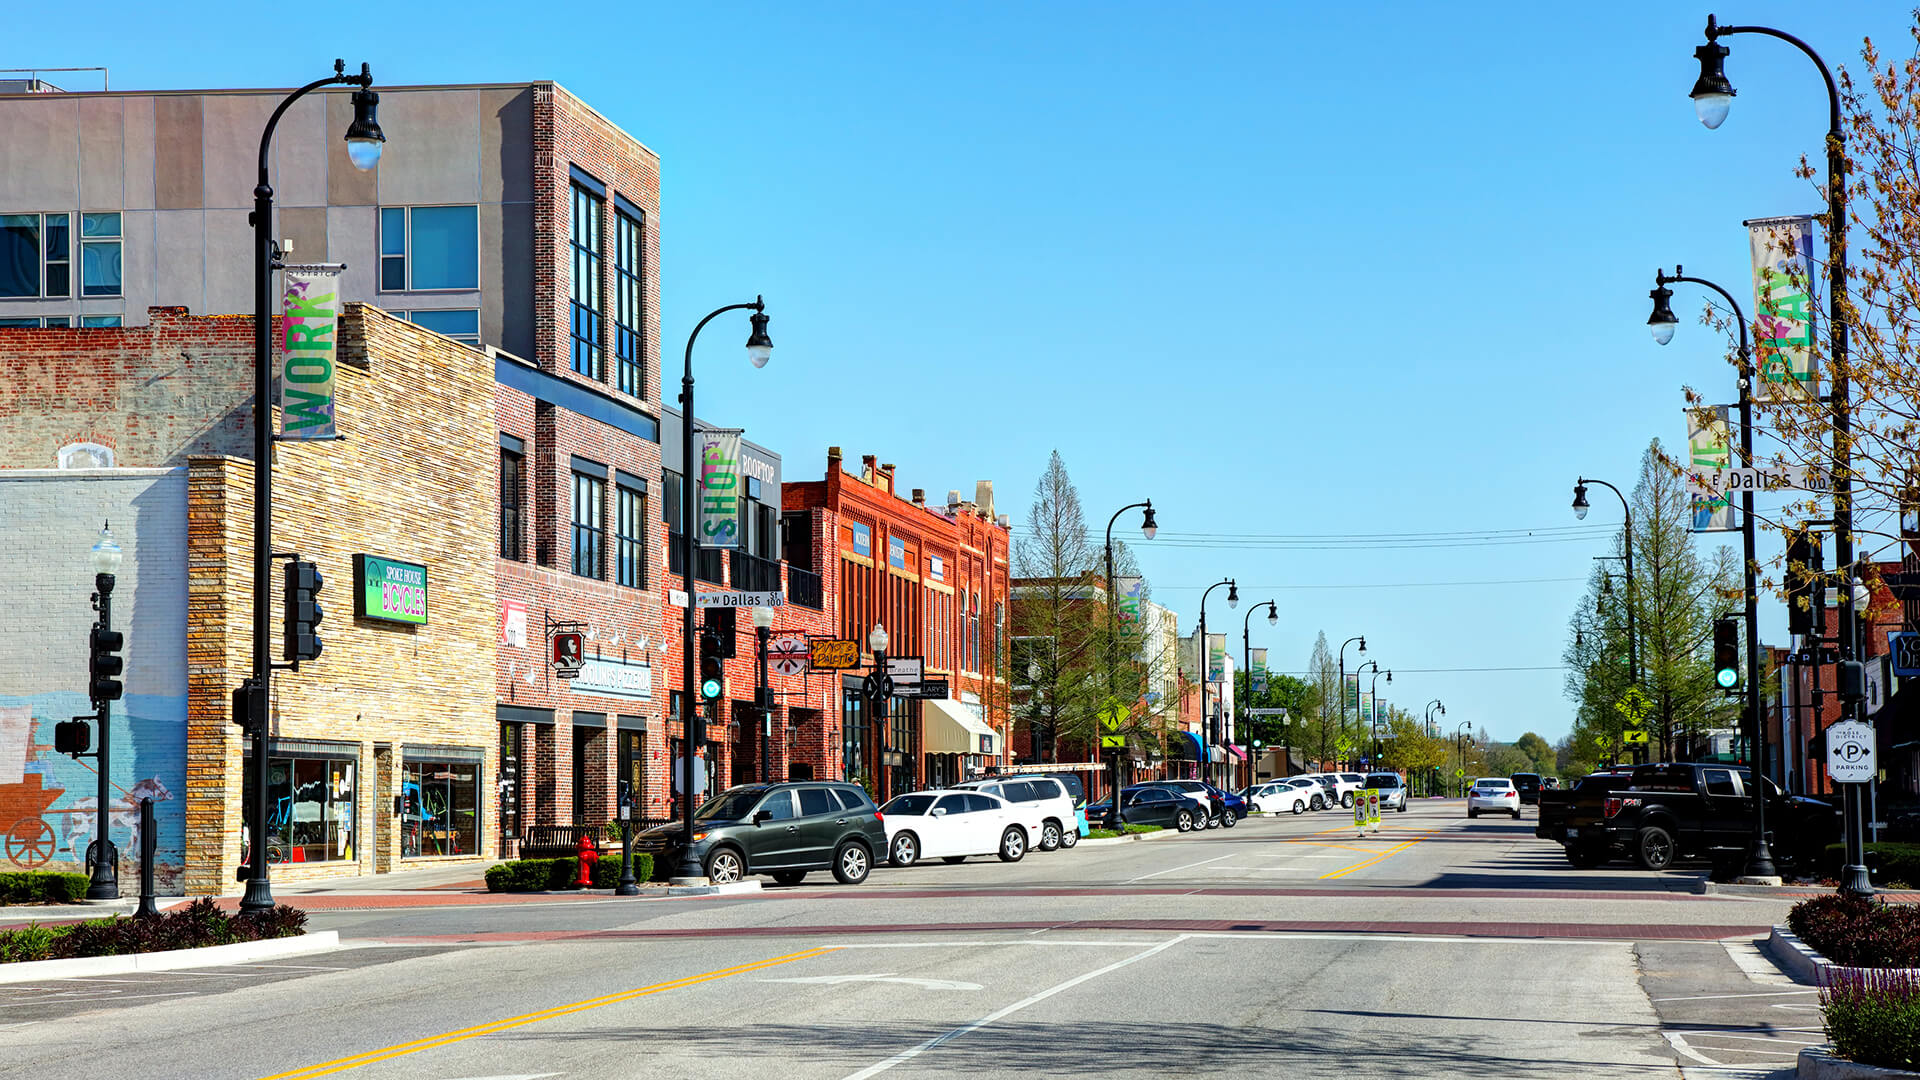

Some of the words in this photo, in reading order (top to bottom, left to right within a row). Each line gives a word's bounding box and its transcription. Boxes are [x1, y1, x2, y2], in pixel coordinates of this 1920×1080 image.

[1757, 267, 1814, 383] PLAY
[284, 291, 336, 432] WORK
[742, 454, 774, 484] ROOFTOP
[1712, 474, 1719, 486] E
[1730, 470, 1792, 489] Dallas
[1802, 478, 1827, 490] 100
[703, 447, 737, 537] SHOP
[386, 566, 403, 582] SPOKE
[403, 569, 422, 585] HOUSE
[382, 581, 425, 617] BICYCLES
[712, 596, 720, 604] W
[723, 593, 761, 606] Dallas
[769, 591, 779, 600] St
[766, 599, 781, 607] 100
[1846, 744, 1859, 760] P
